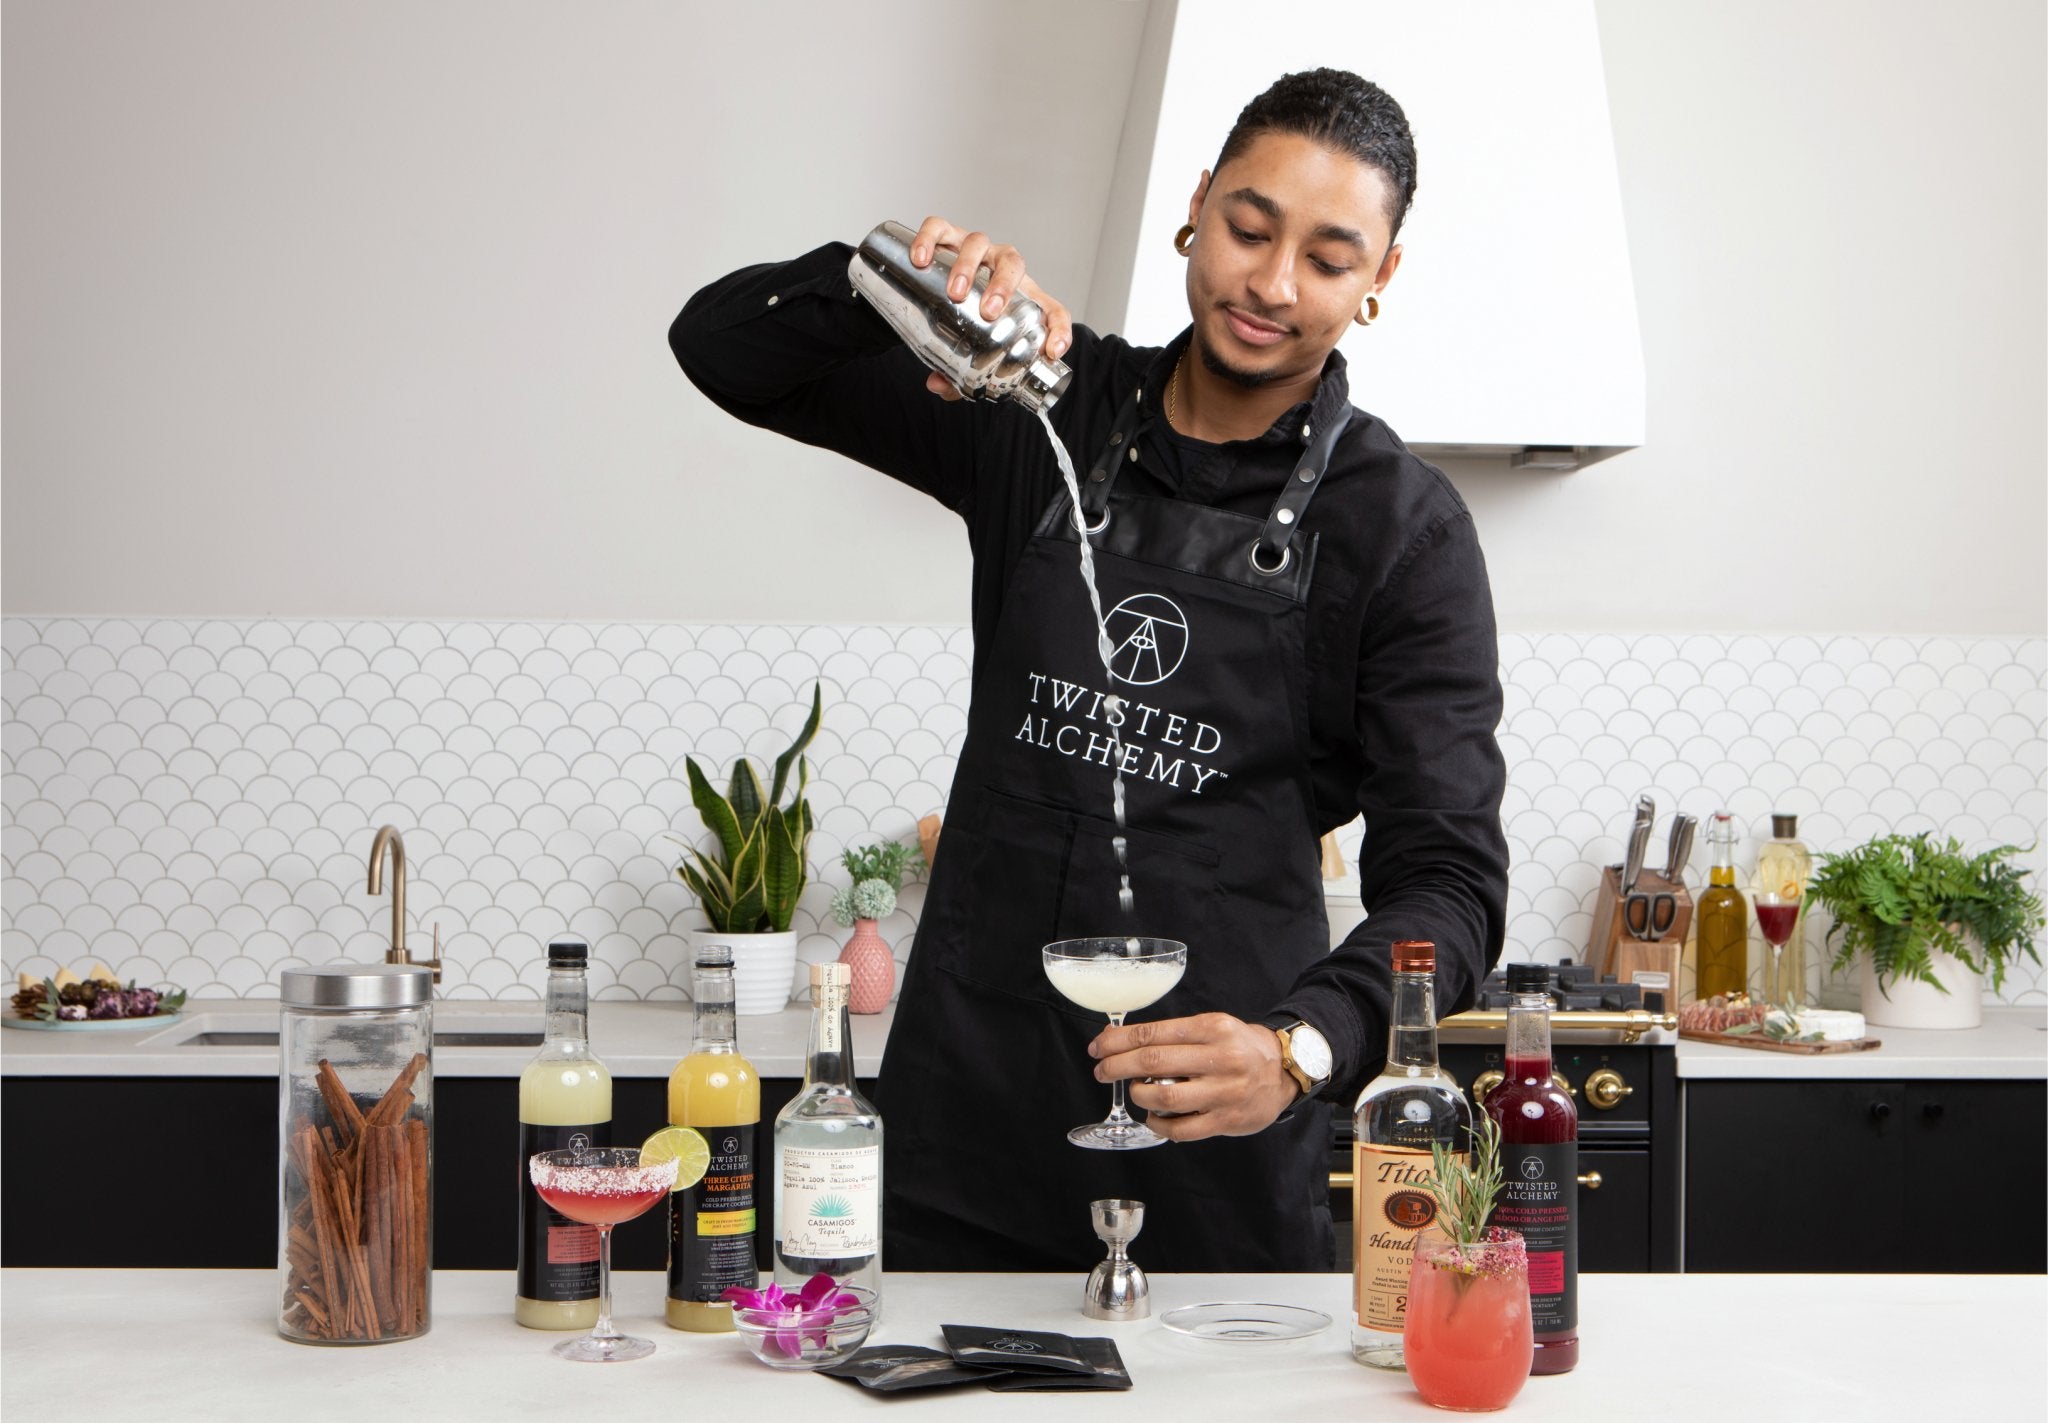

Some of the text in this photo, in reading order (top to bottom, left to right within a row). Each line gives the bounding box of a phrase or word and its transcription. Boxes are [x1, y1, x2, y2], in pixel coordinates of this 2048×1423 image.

[1029, 671, 1221, 754] TWISTED
[711, 1154, 748, 1164] TWISTED
[1377, 1160, 1440, 1185] Tito
[703, 1173, 754, 1184] THREE CITRUS
[706, 1182, 752, 1192] MARGARITA
[1507, 1181, 1557, 1191] TWISTED
[1515, 1207, 1538, 1215] COLD
[1539, 1206, 1568, 1214] PRESSED
[807, 1219, 855, 1227] CASAMIGOS
[818, 1227, 845, 1237] Tequila
[1387, 1256, 1413, 1265] VOD
